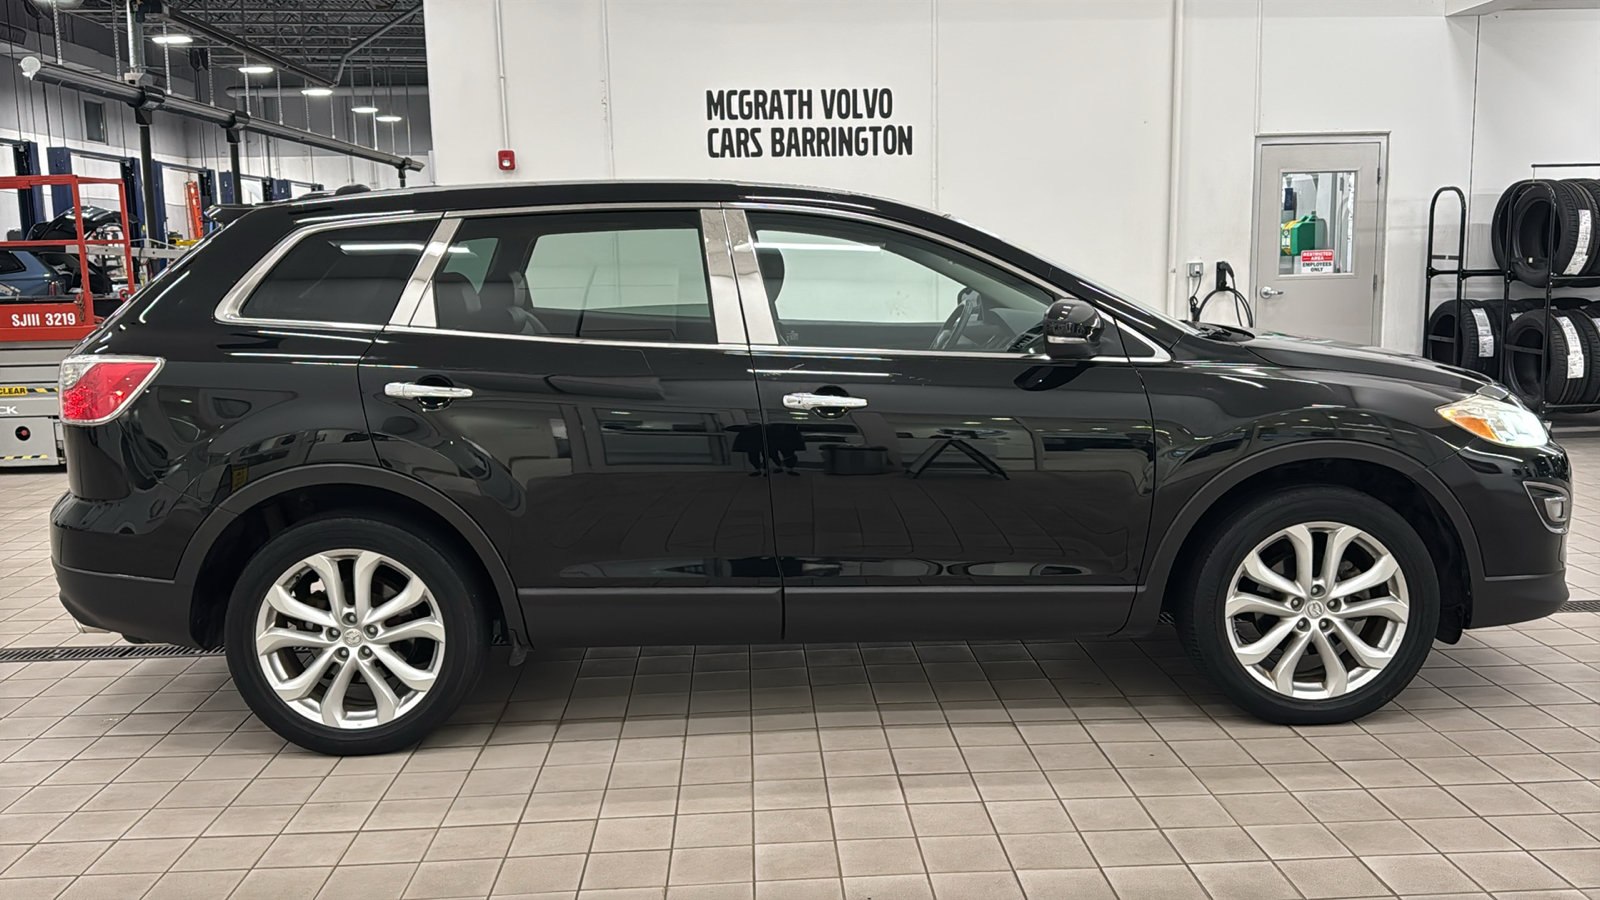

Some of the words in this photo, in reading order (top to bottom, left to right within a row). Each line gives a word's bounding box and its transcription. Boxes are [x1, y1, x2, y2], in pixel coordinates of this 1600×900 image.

[706, 89, 813, 120] MCGRATH
[820, 88, 893, 119] VOLVO
[707, 127, 763, 158] CARS
[771, 124, 913, 157] BARRINGTON
[45, 313, 76, 325] 3219
